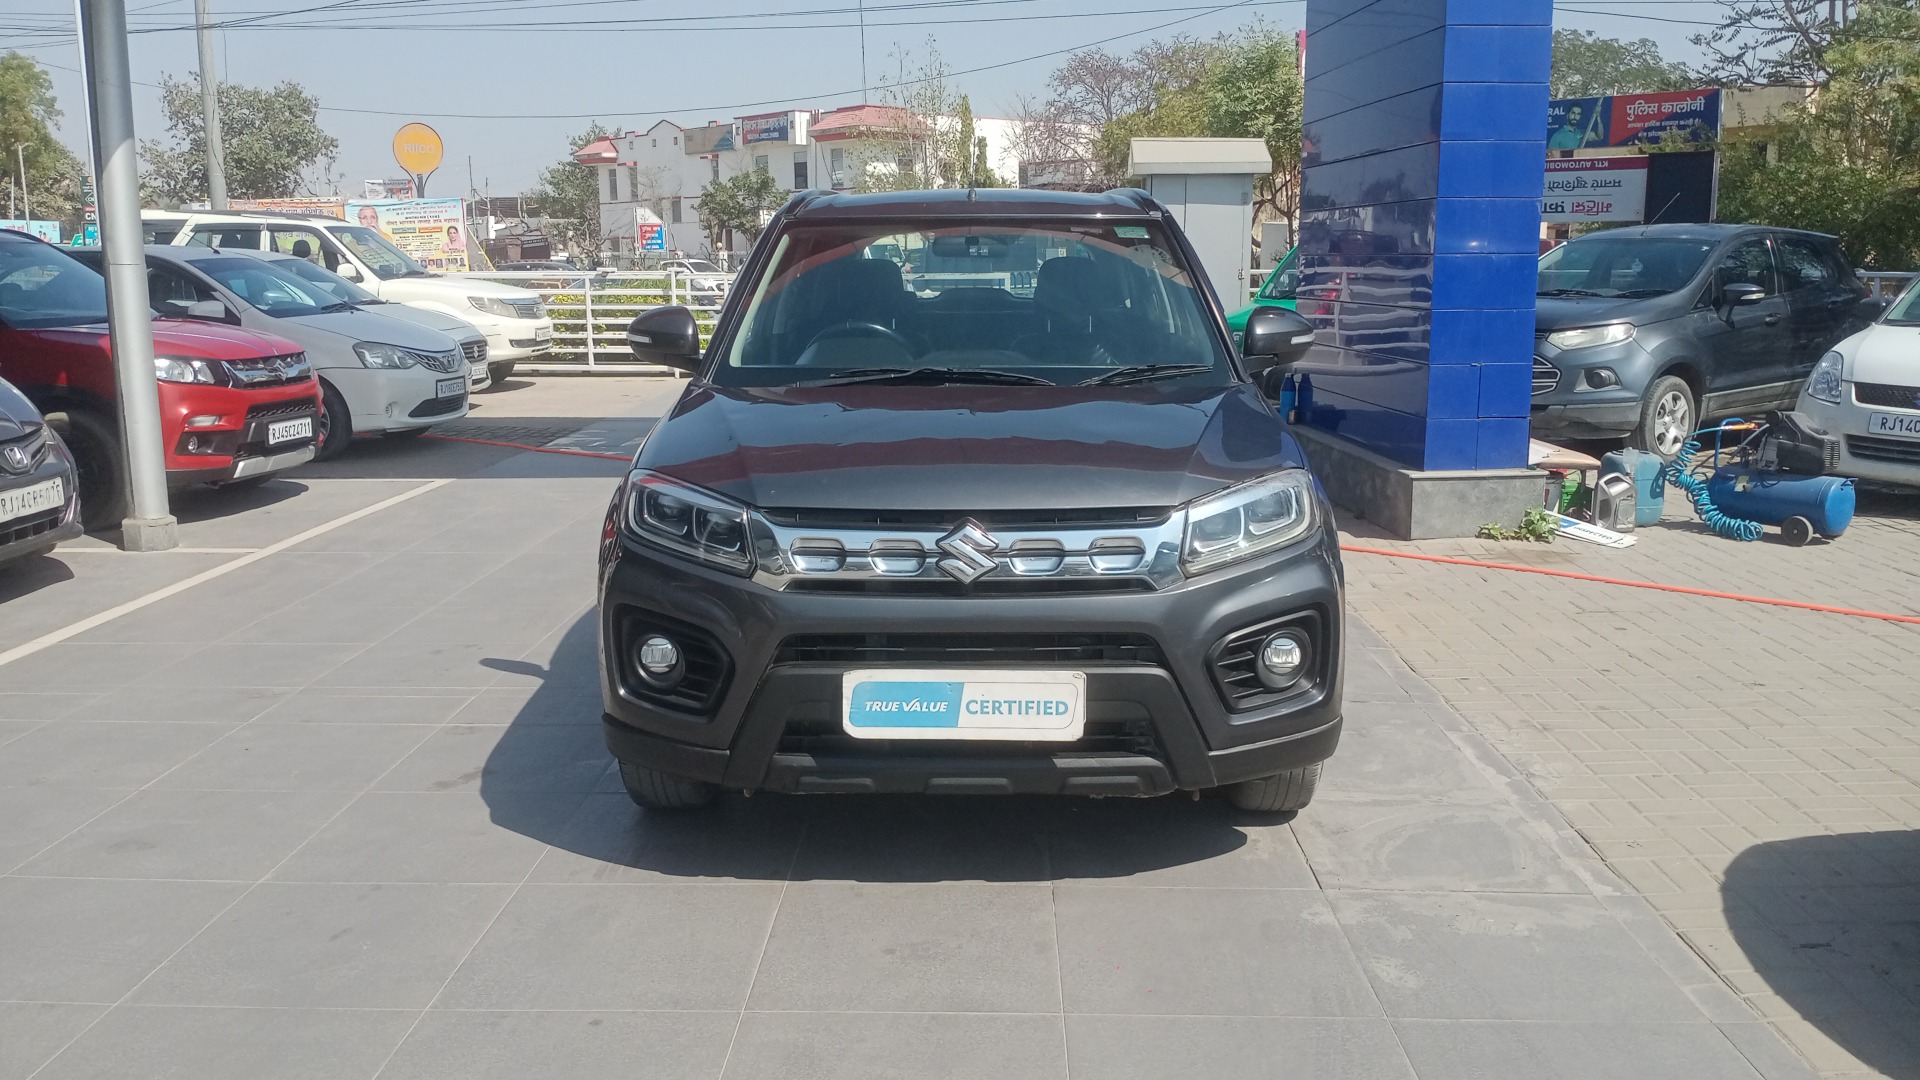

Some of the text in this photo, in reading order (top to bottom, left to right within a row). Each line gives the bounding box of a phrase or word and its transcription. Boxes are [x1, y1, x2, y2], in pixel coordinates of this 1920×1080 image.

[1626, 96, 1705, 121] पुलिस कालोनी
[1545, 160, 1609, 170] KTL AUTOMOBI
[272, 421, 311, 441] RJ45CZ4711
[865, 697, 1069, 716] TRUE VALUE CERTIFIED
